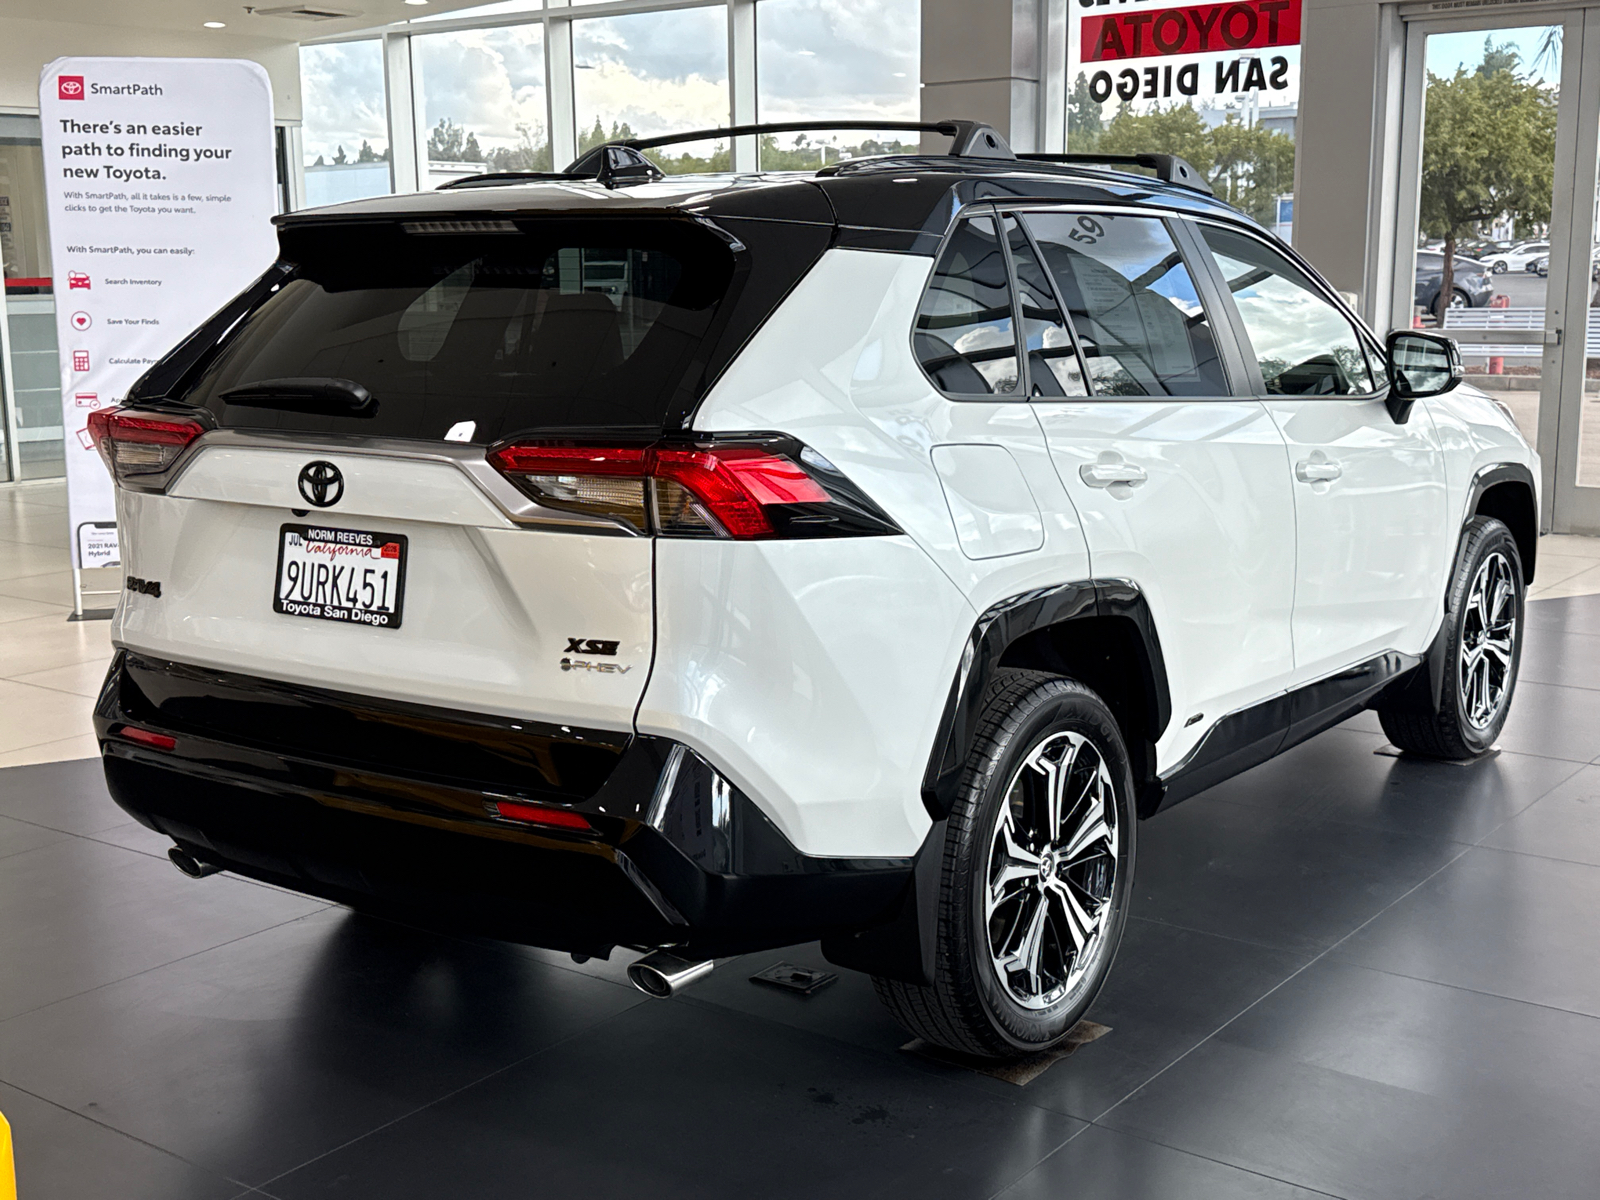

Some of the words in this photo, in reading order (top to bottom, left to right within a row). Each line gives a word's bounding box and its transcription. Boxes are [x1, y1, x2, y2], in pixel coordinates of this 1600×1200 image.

[90, 82, 163, 96] SmartPath
[126, 124, 147, 134] an
[151, 122, 203, 136] easier
[61, 142, 102, 159] path
[106, 144, 125, 157] to
[128, 143, 190, 161] finding
[193, 148, 232, 162] your
[63, 167, 99, 178] new
[103, 165, 167, 182] Toyota.
[64, 192, 83, 200] With
[84, 192, 128, 201] SmartPath,
[150, 193, 171, 201] takes
[206, 194, 232, 203] simple
[99, 206, 112, 214] get
[129, 205, 156, 214] Toyota
[89, 246, 135, 254] SmartPath,
[288, 534, 303, 547] JUL
[308, 528, 335, 541] NORM
[336, 531, 373, 546] REEVES
[305, 539, 381, 562] California
[285, 560, 390, 612] 9URK451
[281, 599, 321, 616] Toyota
[324, 605, 348, 619] San
[351, 609, 389, 626] Diego
[563, 637, 620, 656] XSE
